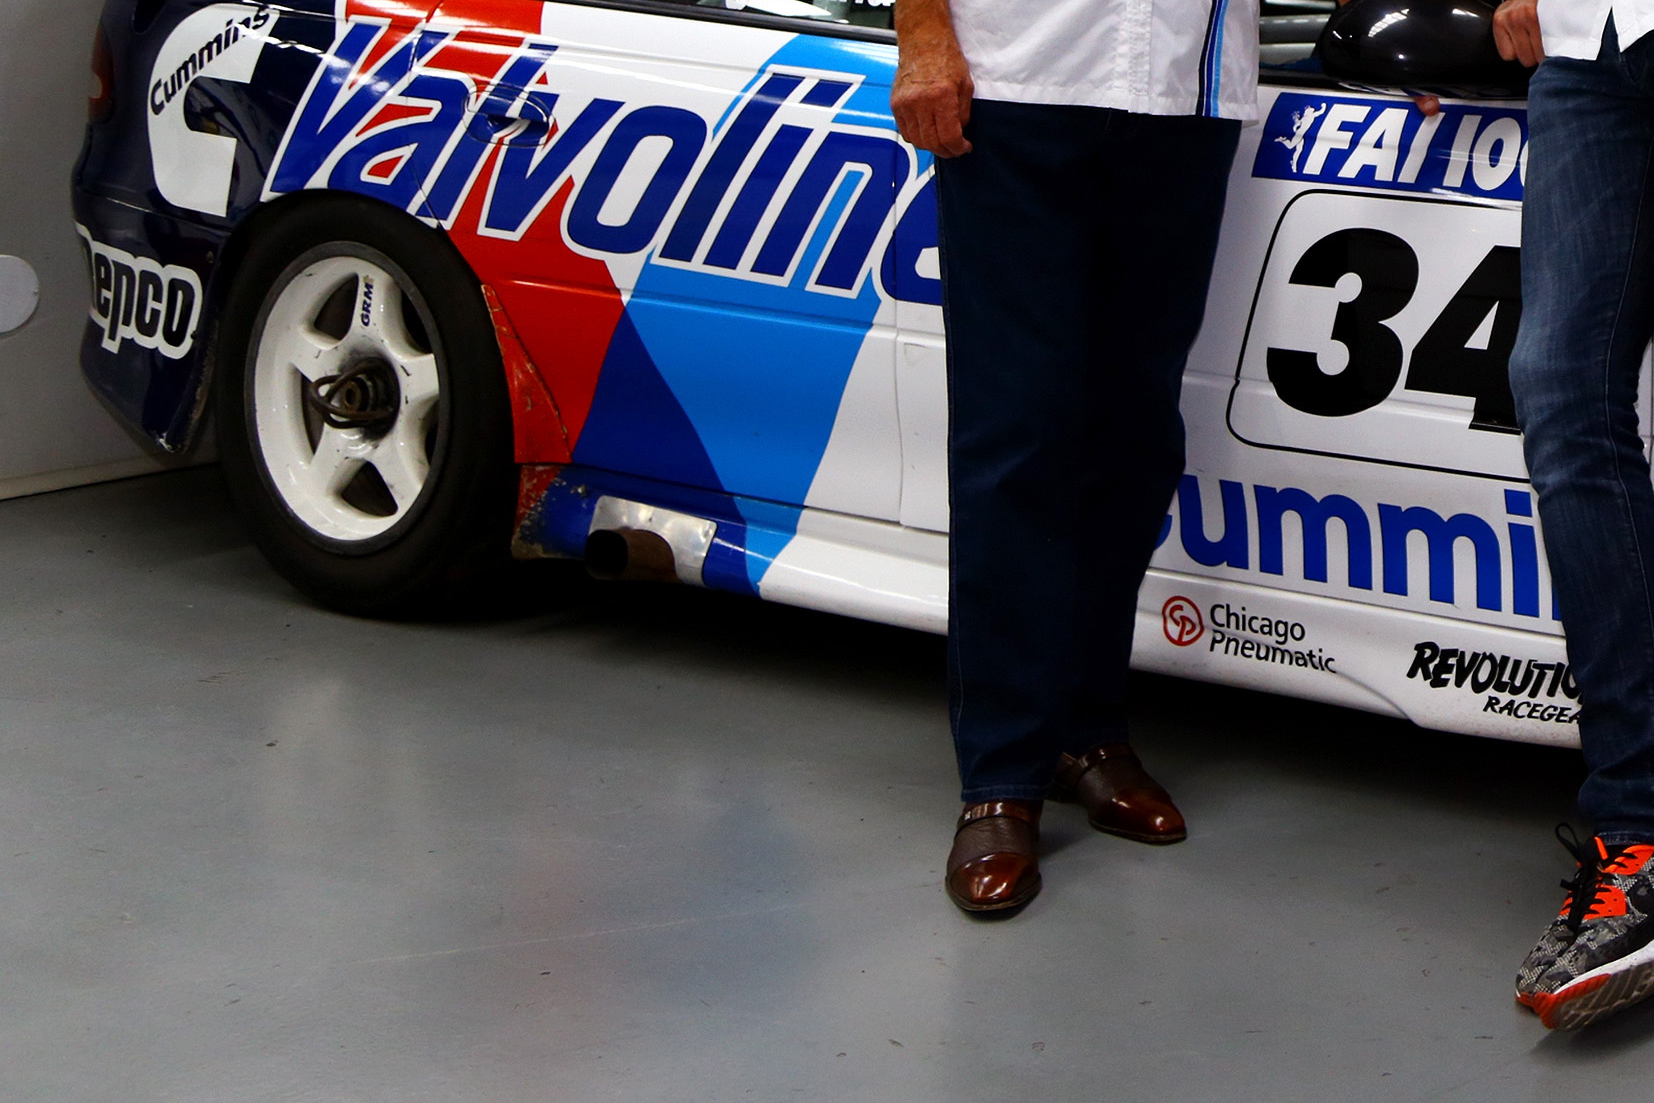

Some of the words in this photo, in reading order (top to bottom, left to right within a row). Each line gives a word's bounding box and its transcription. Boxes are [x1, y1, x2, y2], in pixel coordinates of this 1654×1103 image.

[150, 6, 270, 116] Cummins
[1303, 103, 1446, 184] FAI
[1442, 113, 1528, 191] 10
[92, 248, 196, 348] epco
[360, 282, 374, 327] GRM
[1266, 227, 1523, 436] 34
[1153, 473, 1562, 622] ummi
[1209, 603, 1307, 644] Chicago
[1209, 629, 1339, 675] Pneumatic
